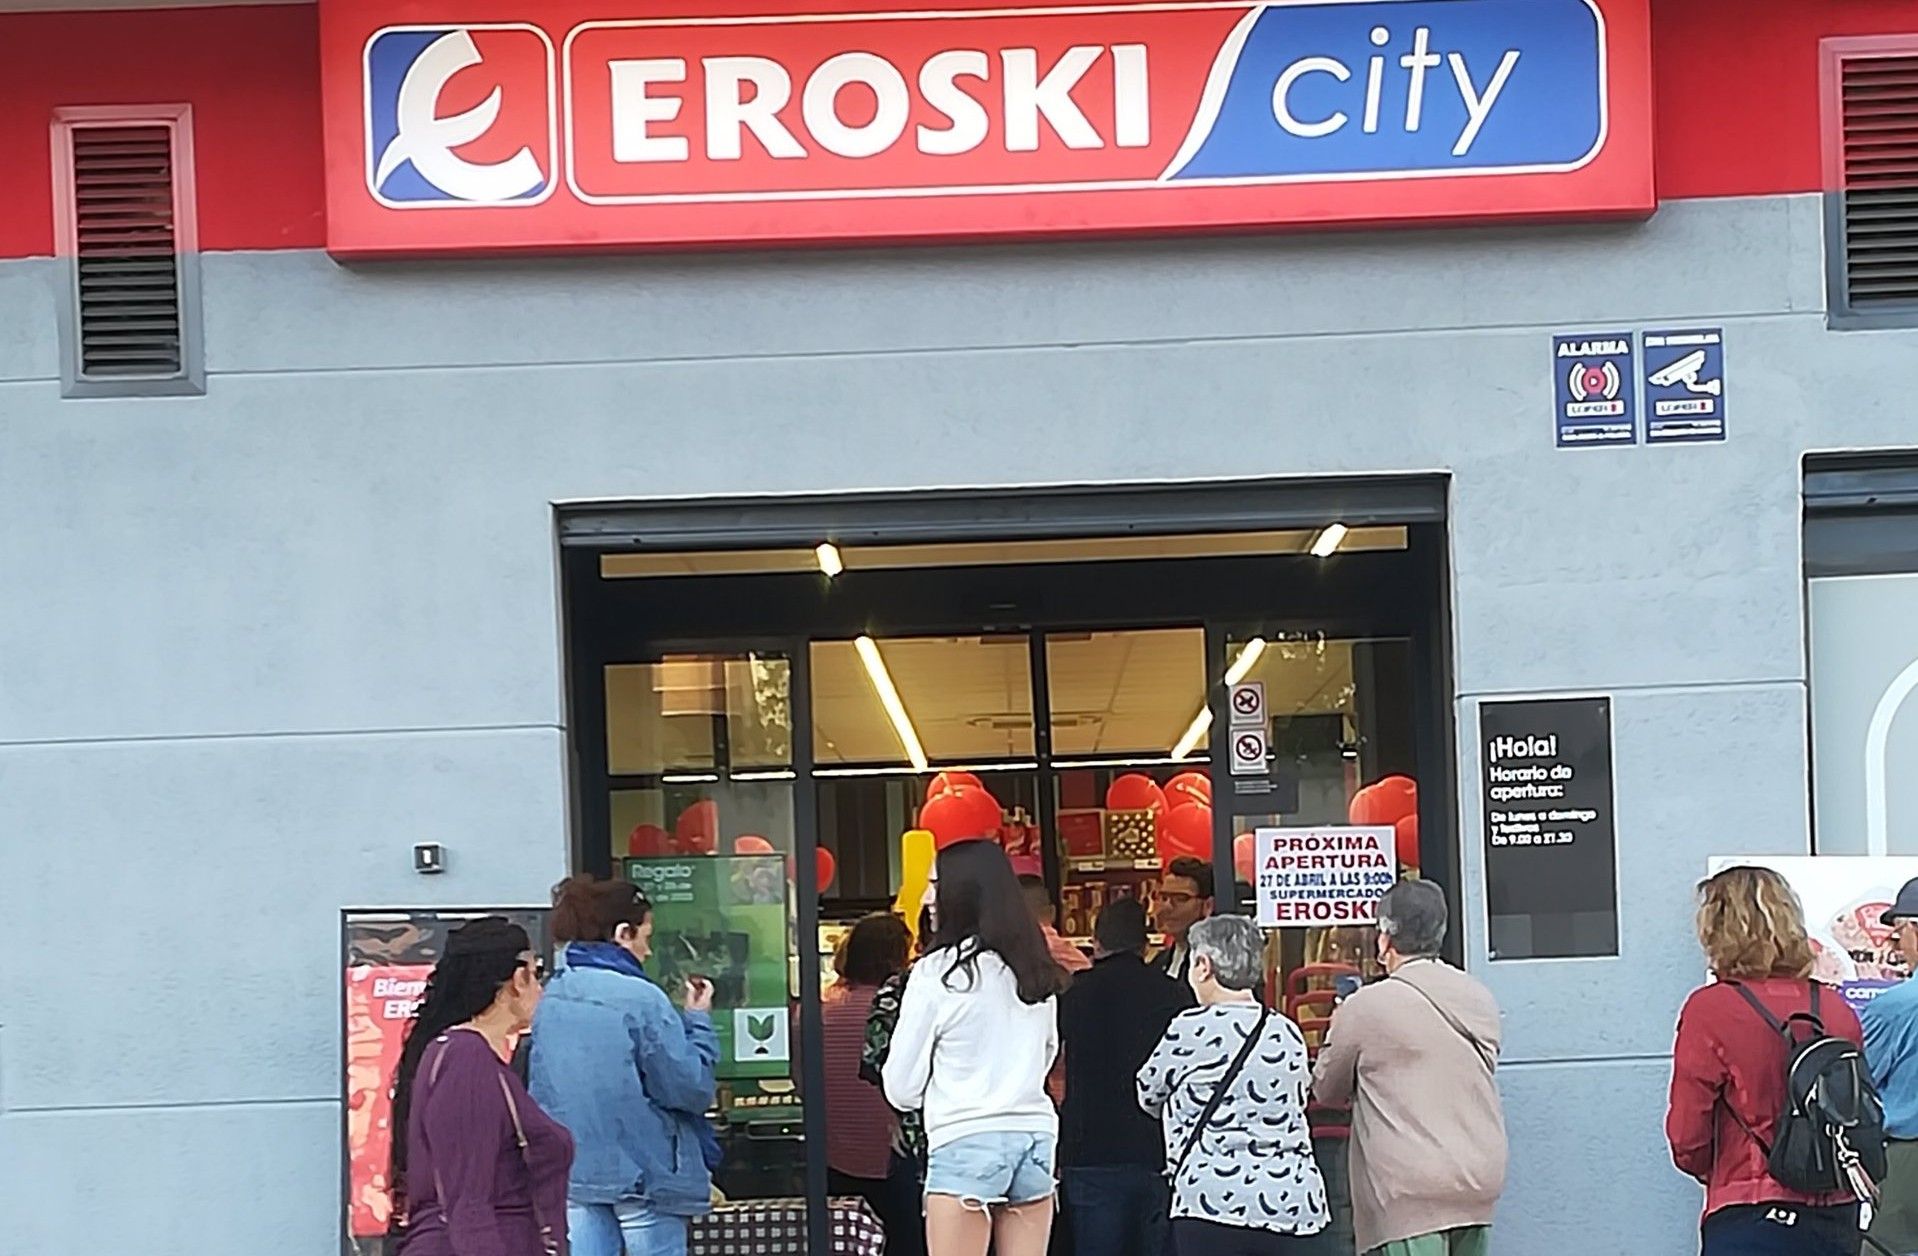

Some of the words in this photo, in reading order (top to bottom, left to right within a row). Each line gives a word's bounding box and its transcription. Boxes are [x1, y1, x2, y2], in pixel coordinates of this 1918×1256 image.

[1271, 26, 1521, 157] city
[607, 43, 1150, 163] EROSKI
[1557, 339, 1629, 357] ALARMA
[1490, 766, 1548, 782] Horario
[1265, 853, 1388, 869] APERTURA
[1260, 875, 1274, 887] 27
[1276, 874, 1291, 887] DE
[1294, 873, 1326, 886] ABRIL
[1329, 873, 1337, 886] A
[1340, 872, 1360, 885] LAS
[1270, 888, 1385, 899] SUPERMERCADO
